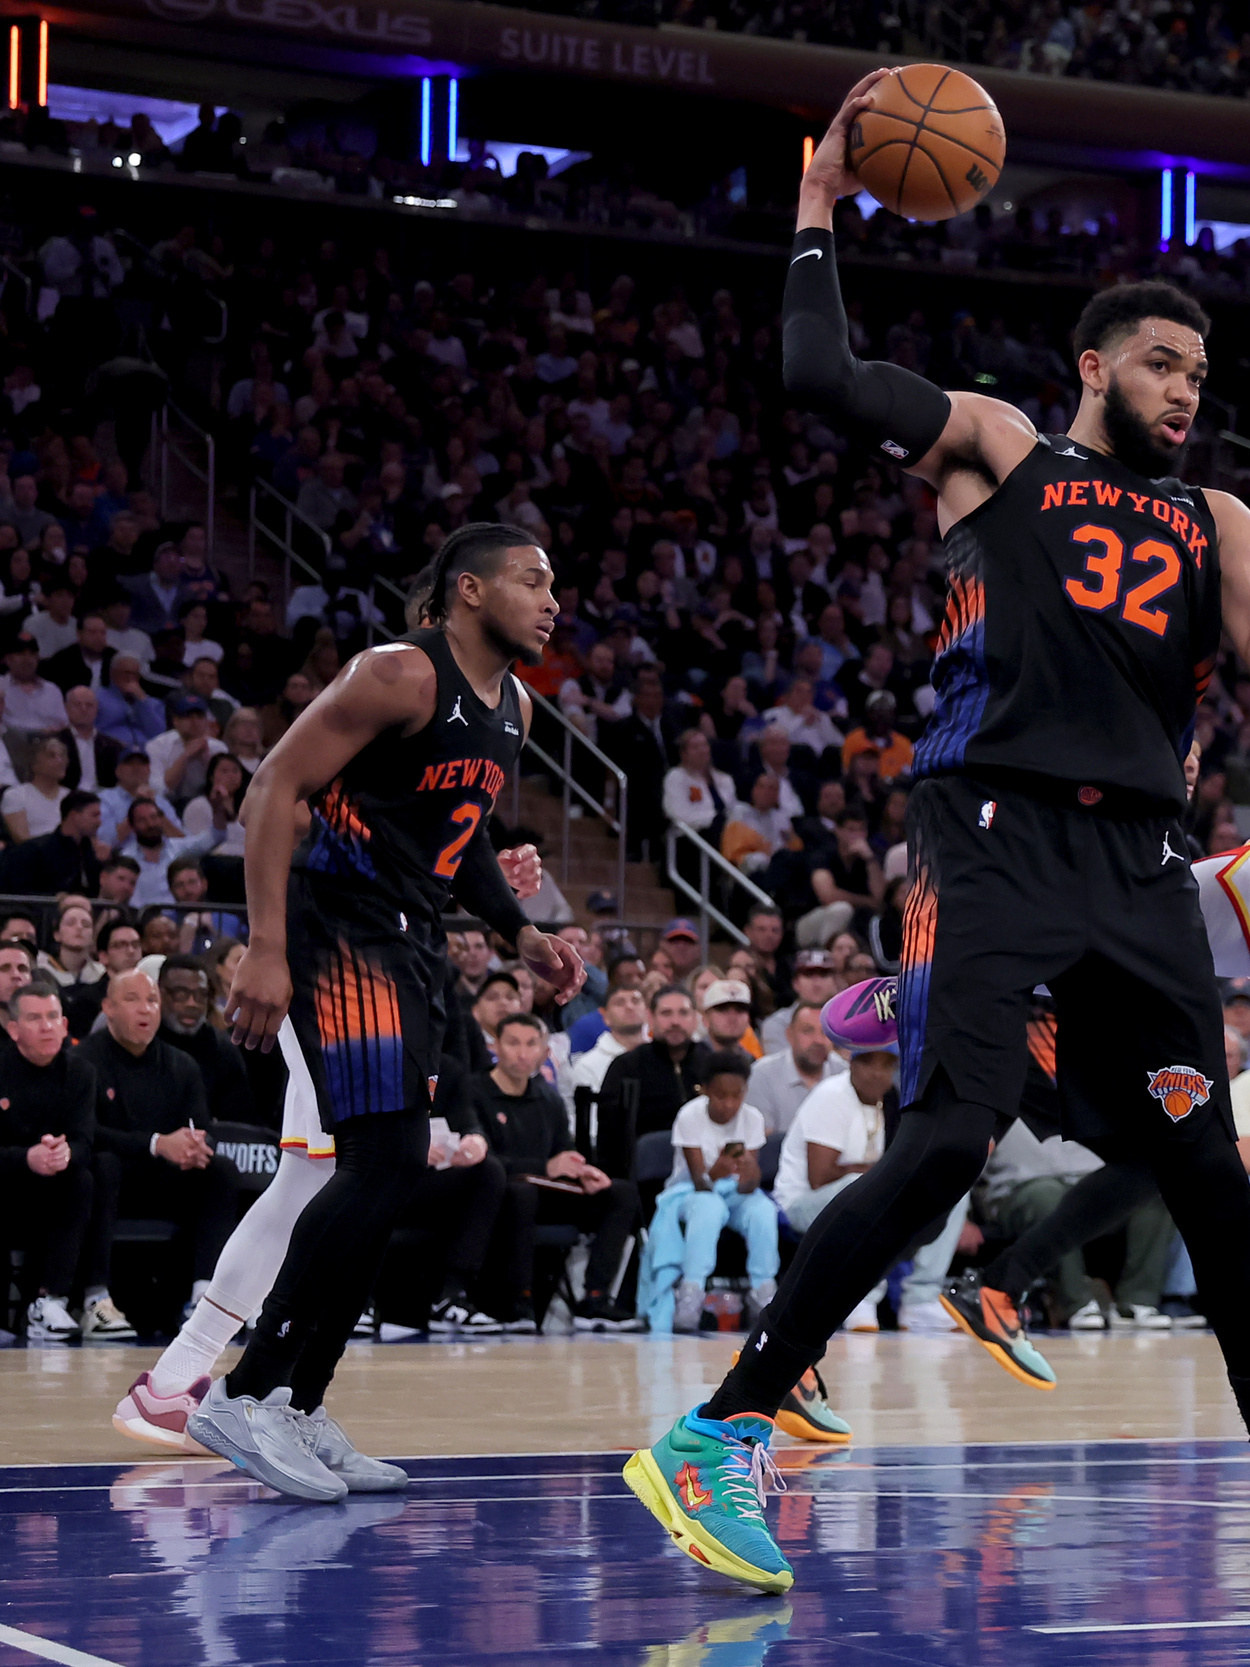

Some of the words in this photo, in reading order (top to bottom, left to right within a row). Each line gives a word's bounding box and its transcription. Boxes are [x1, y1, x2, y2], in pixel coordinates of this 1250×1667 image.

[499, 28, 600, 70] SUITE
[613, 41, 714, 84] LEVEL
[1041, 480, 1122, 511] NEW
[1127, 492, 1209, 569] YORK
[1063, 522, 1183, 639] 32
[416, 758, 482, 791] NEW
[480, 759, 505, 800] YOR
[432, 801, 482, 879] 2
[1150, 1070, 1208, 1099] KNICKS
[216, 1141, 278, 1174] AYOFFS
